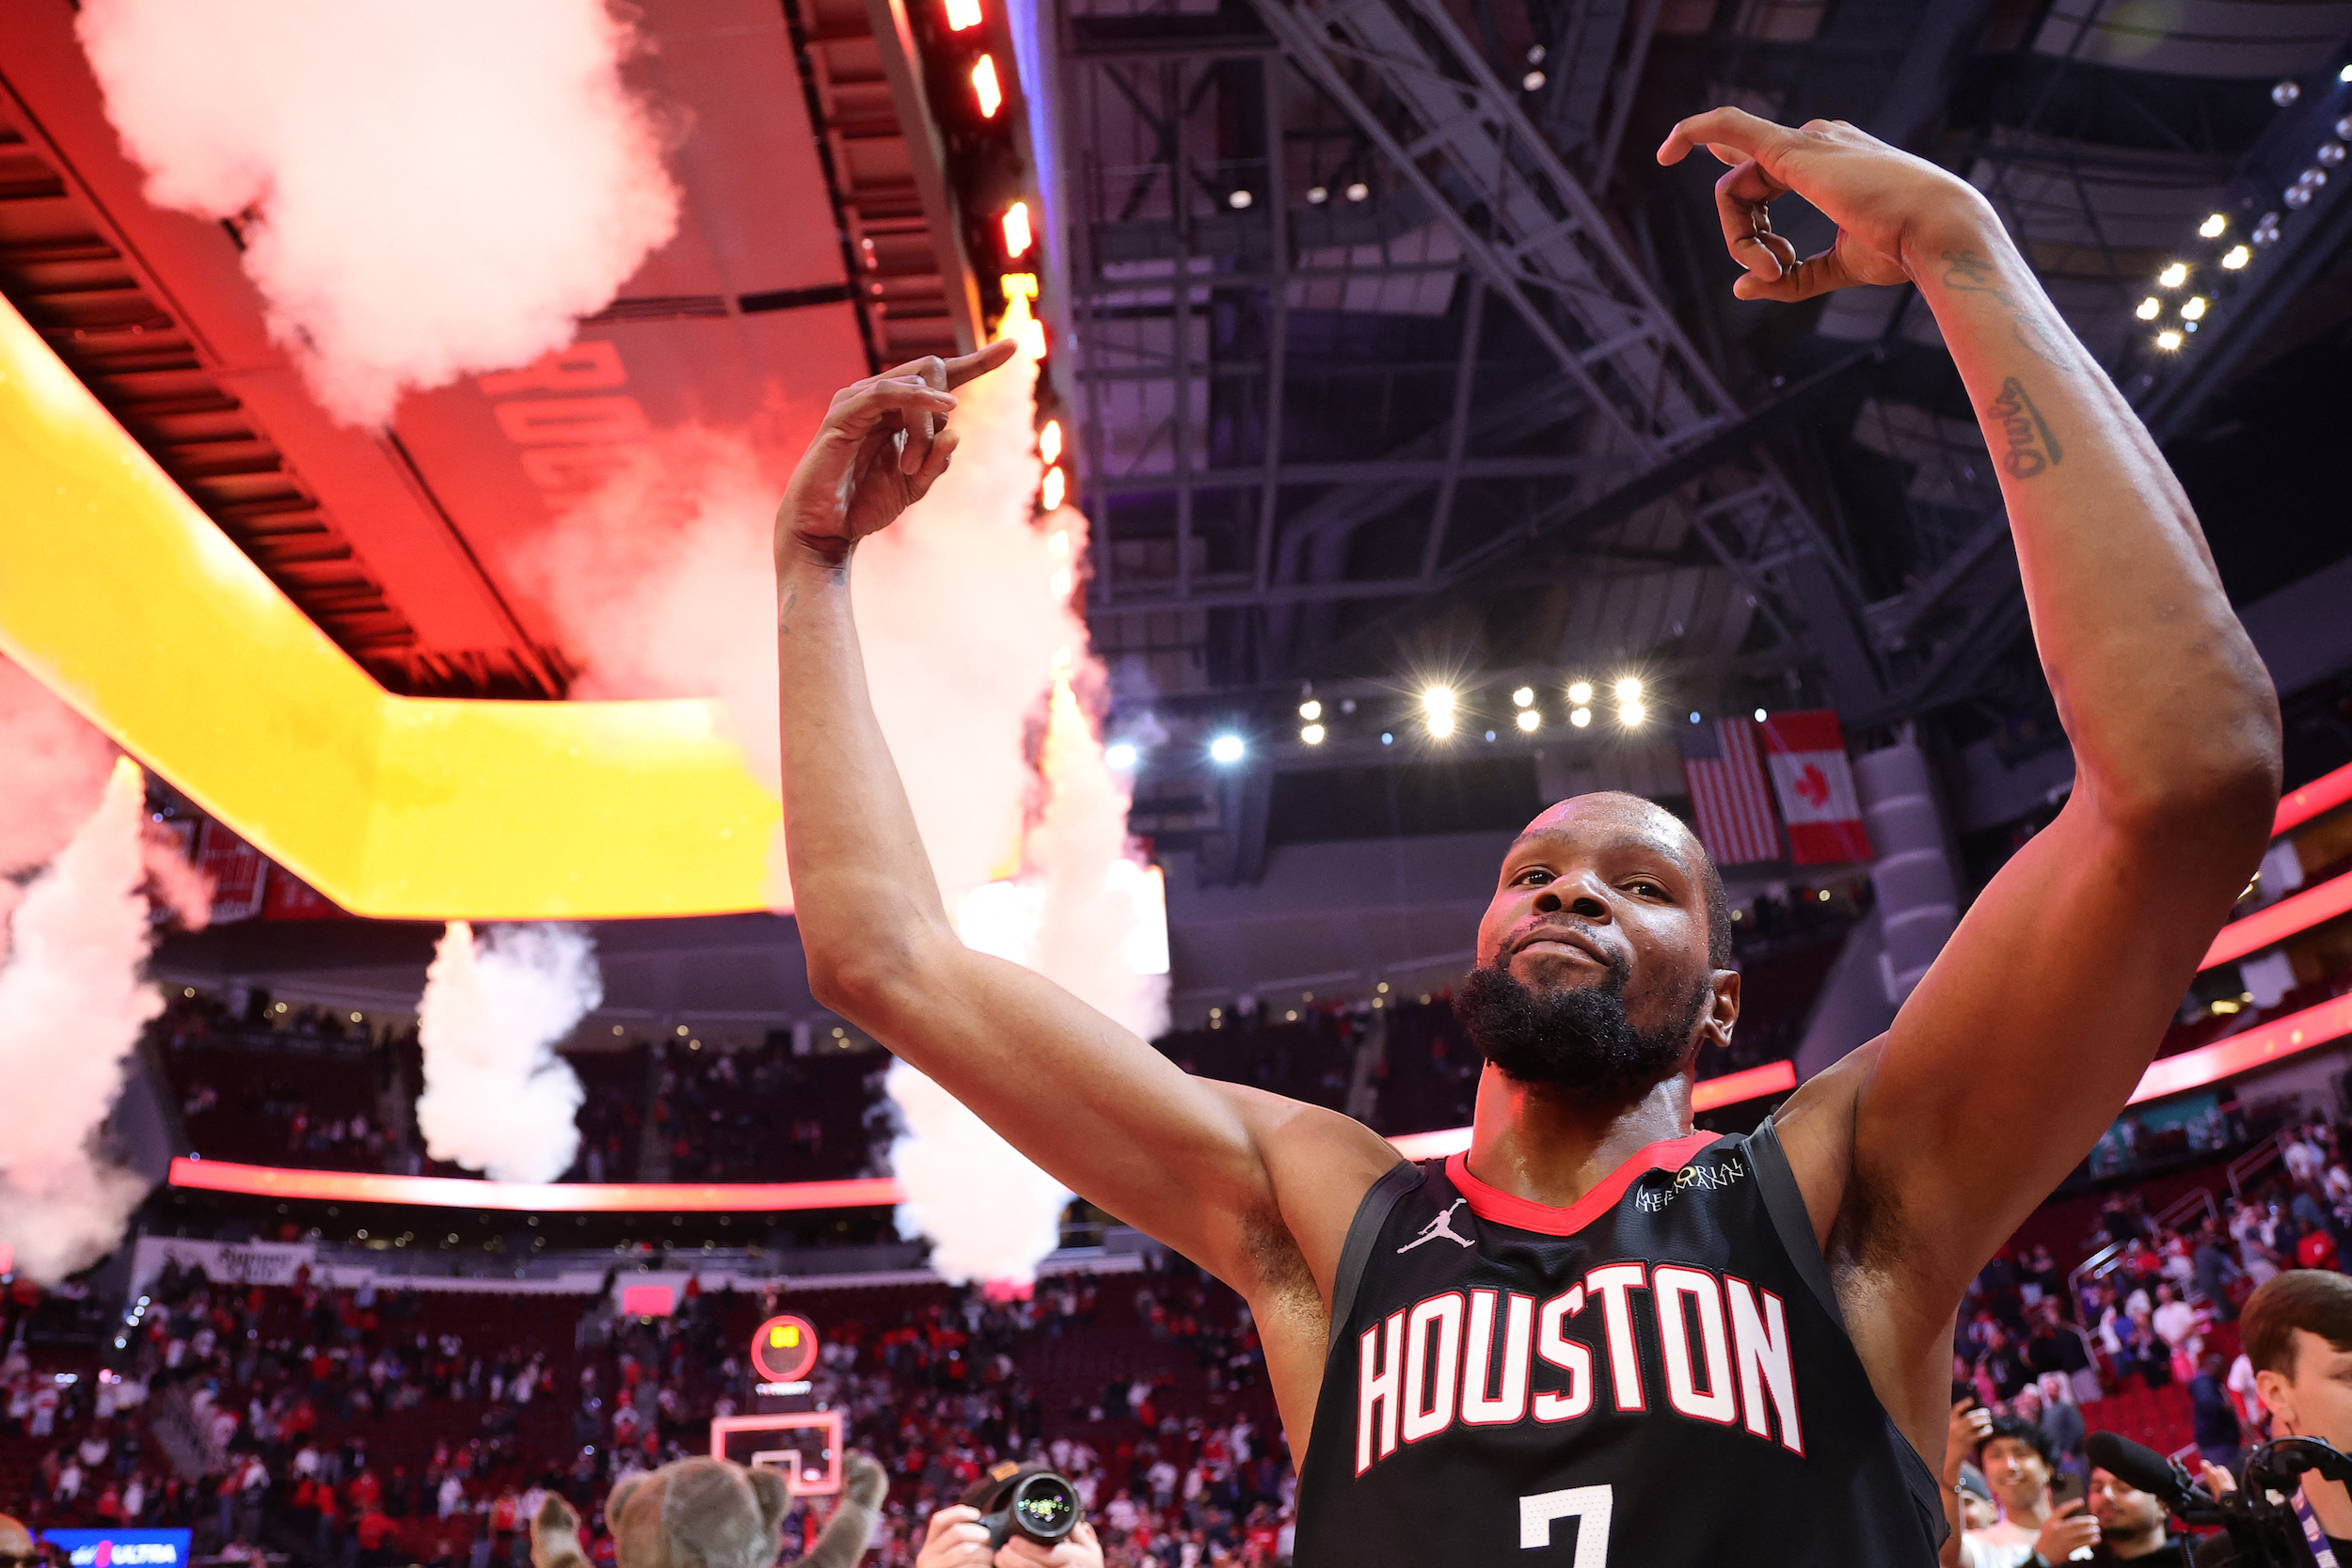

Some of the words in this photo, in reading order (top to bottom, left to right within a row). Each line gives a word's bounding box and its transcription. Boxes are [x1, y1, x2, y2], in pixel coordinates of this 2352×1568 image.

[1636, 1158, 1742, 1205] MEORIAL
[1355, 1261, 1805, 1479] HOUSTON
[1518, 1483, 1613, 1568] 7
